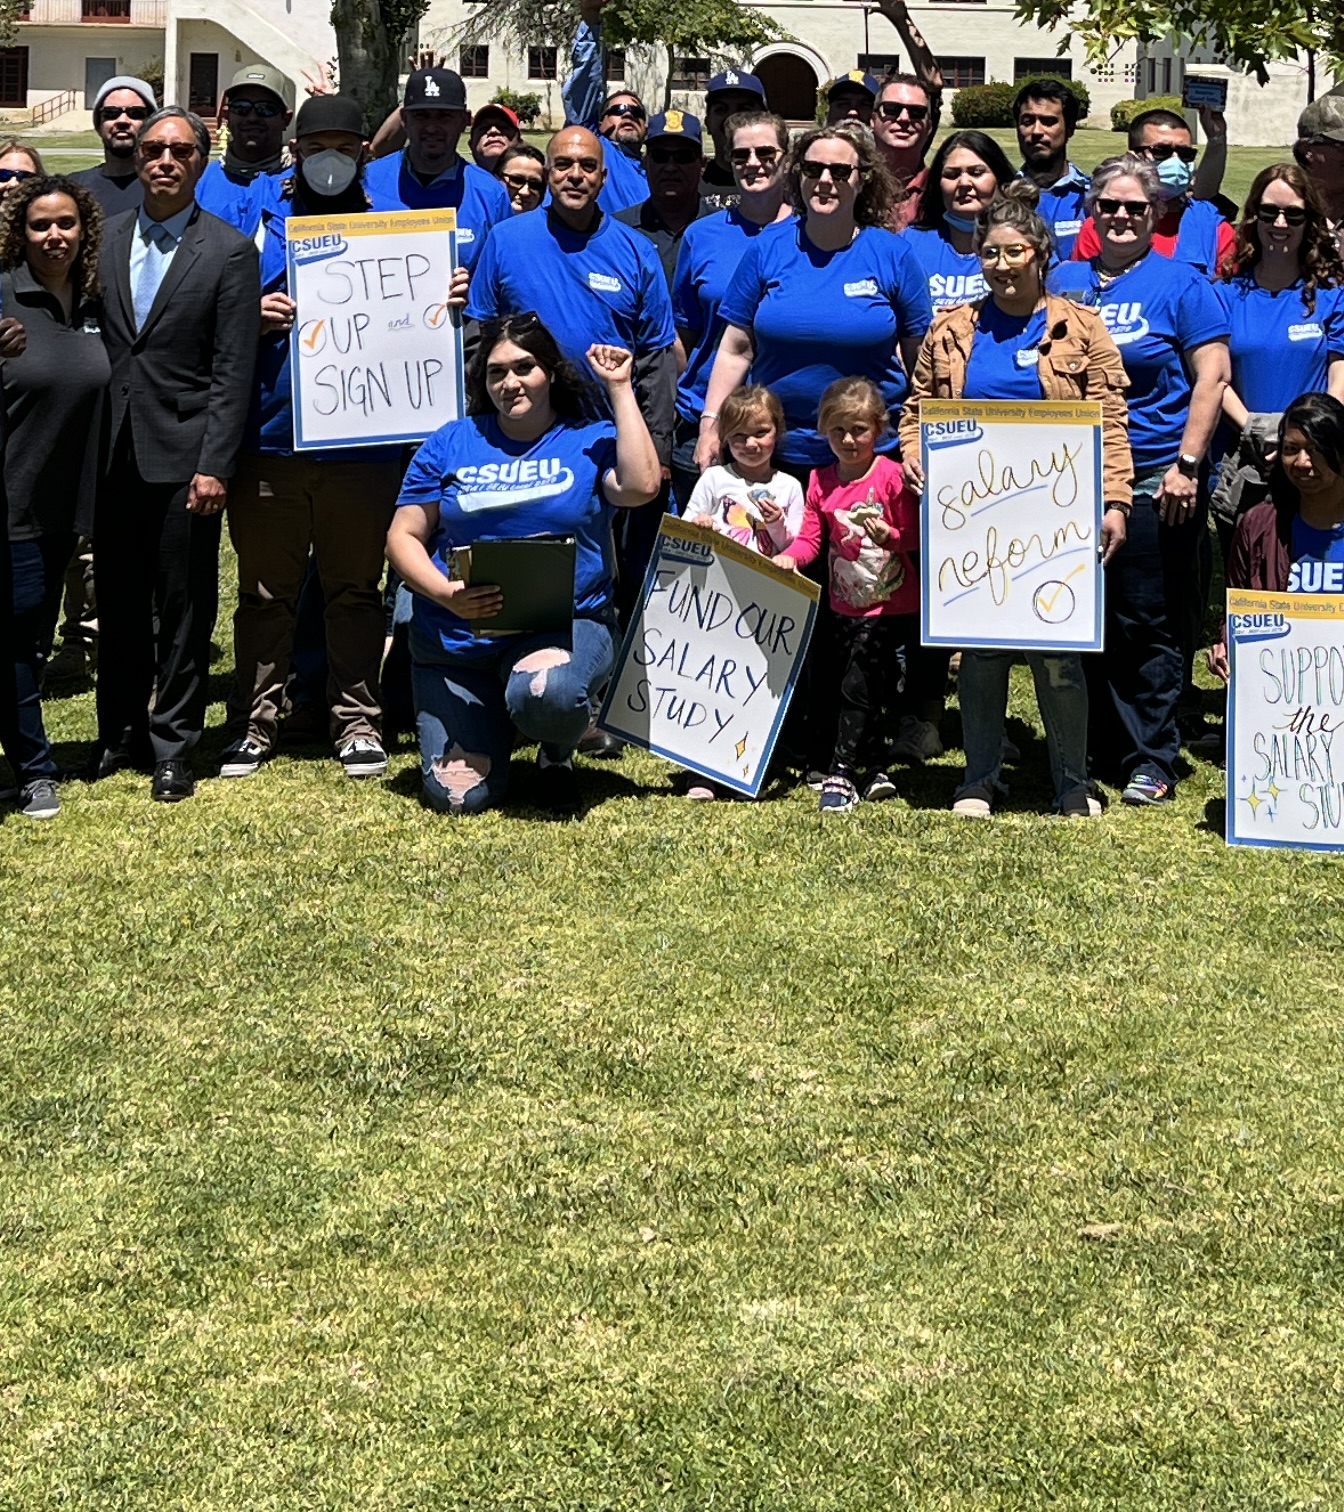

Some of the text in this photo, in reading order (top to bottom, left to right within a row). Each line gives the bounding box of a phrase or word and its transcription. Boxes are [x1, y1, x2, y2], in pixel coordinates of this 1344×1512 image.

[424, 76, 440, 97] LA
[289, 223, 325, 234] California
[327, 222, 347, 232] State
[350, 219, 388, 230] University
[390, 217, 430, 229] Employees
[292, 233, 342, 253] CSUEU
[317, 253, 431, 305] STEP
[330, 313, 370, 354] UP
[313, 359, 443, 417] SIGN UP
[922, 406, 1101, 419] California State University Employees Union
[925, 418, 977, 436] CSUEU
[456, 458, 560, 484] CSUEU
[937, 442, 1083, 531] salary
[662, 536, 712, 557] CSUEU
[939, 521, 1092, 606] reform
[644, 569, 795, 656] FUND OUR
[1229, 597, 1268, 610] California
[1269, 599, 1291, 611] State
[1293, 601, 1336, 615] University
[1233, 614, 1285, 629] CSUEU
[633, 628, 768, 706] SALARY
[627, 678, 735, 744] STUDY
[1254, 731, 1335, 788] SALARY
